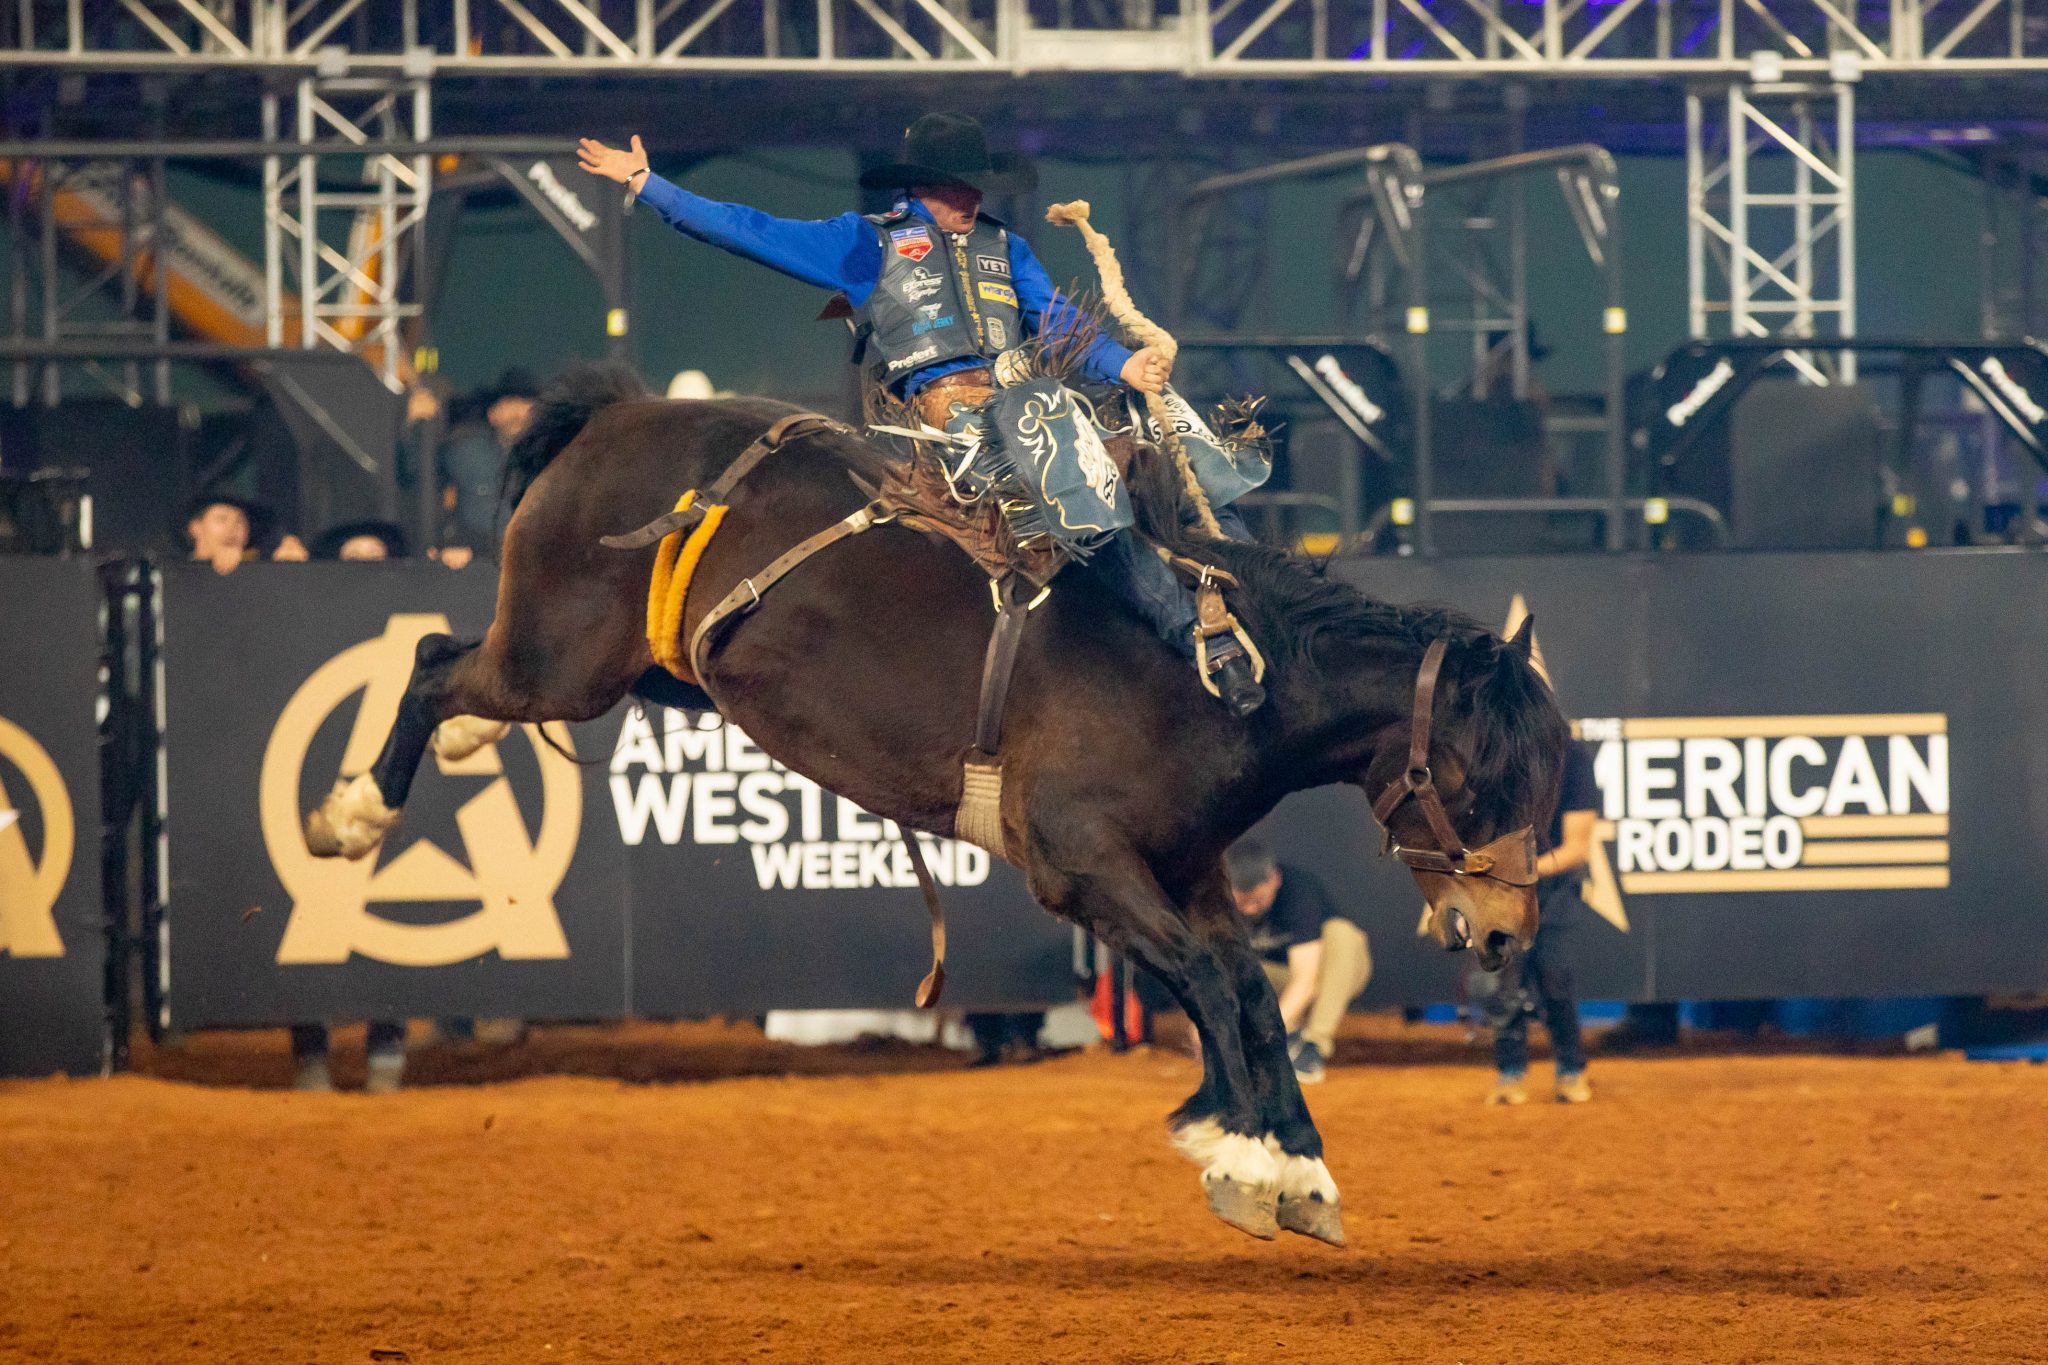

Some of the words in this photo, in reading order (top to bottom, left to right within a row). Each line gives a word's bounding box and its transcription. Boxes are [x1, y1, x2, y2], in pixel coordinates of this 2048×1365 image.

[609, 705, 788, 773] AME
[608, 771, 935, 846] WESTE
[750, 841, 991, 890] WEEKEND
[1616, 815, 1804, 873] RODEO
